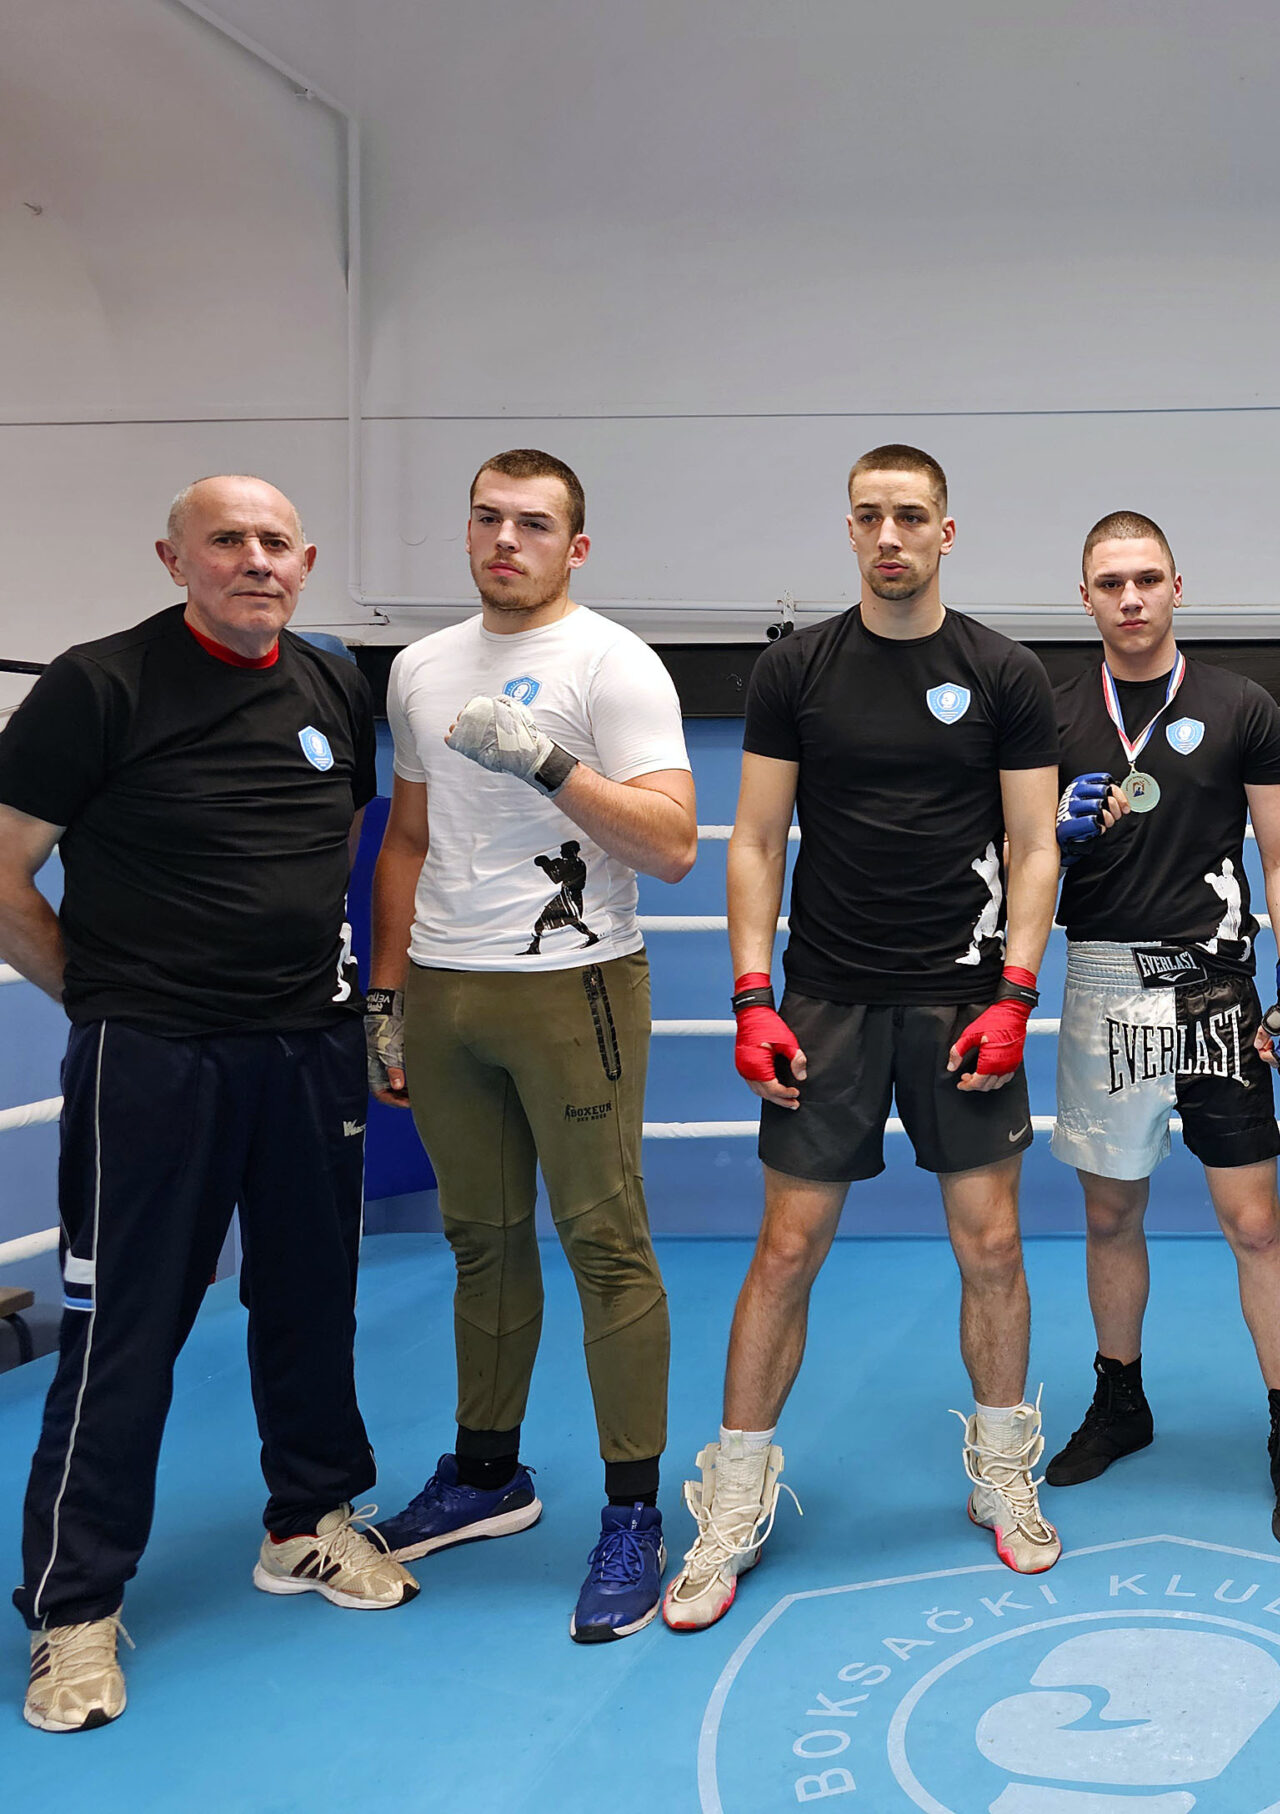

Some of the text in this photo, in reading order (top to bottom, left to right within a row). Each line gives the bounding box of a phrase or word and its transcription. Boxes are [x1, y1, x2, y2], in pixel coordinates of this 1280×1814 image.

[1136, 951, 1201, 978] EVERLAST
[1106, 1003, 1247, 1097] EVERLAST
[570, 1102, 612, 1118] BOXEUR
[794, 1584, 1058, 1803] BOKSAČKI
